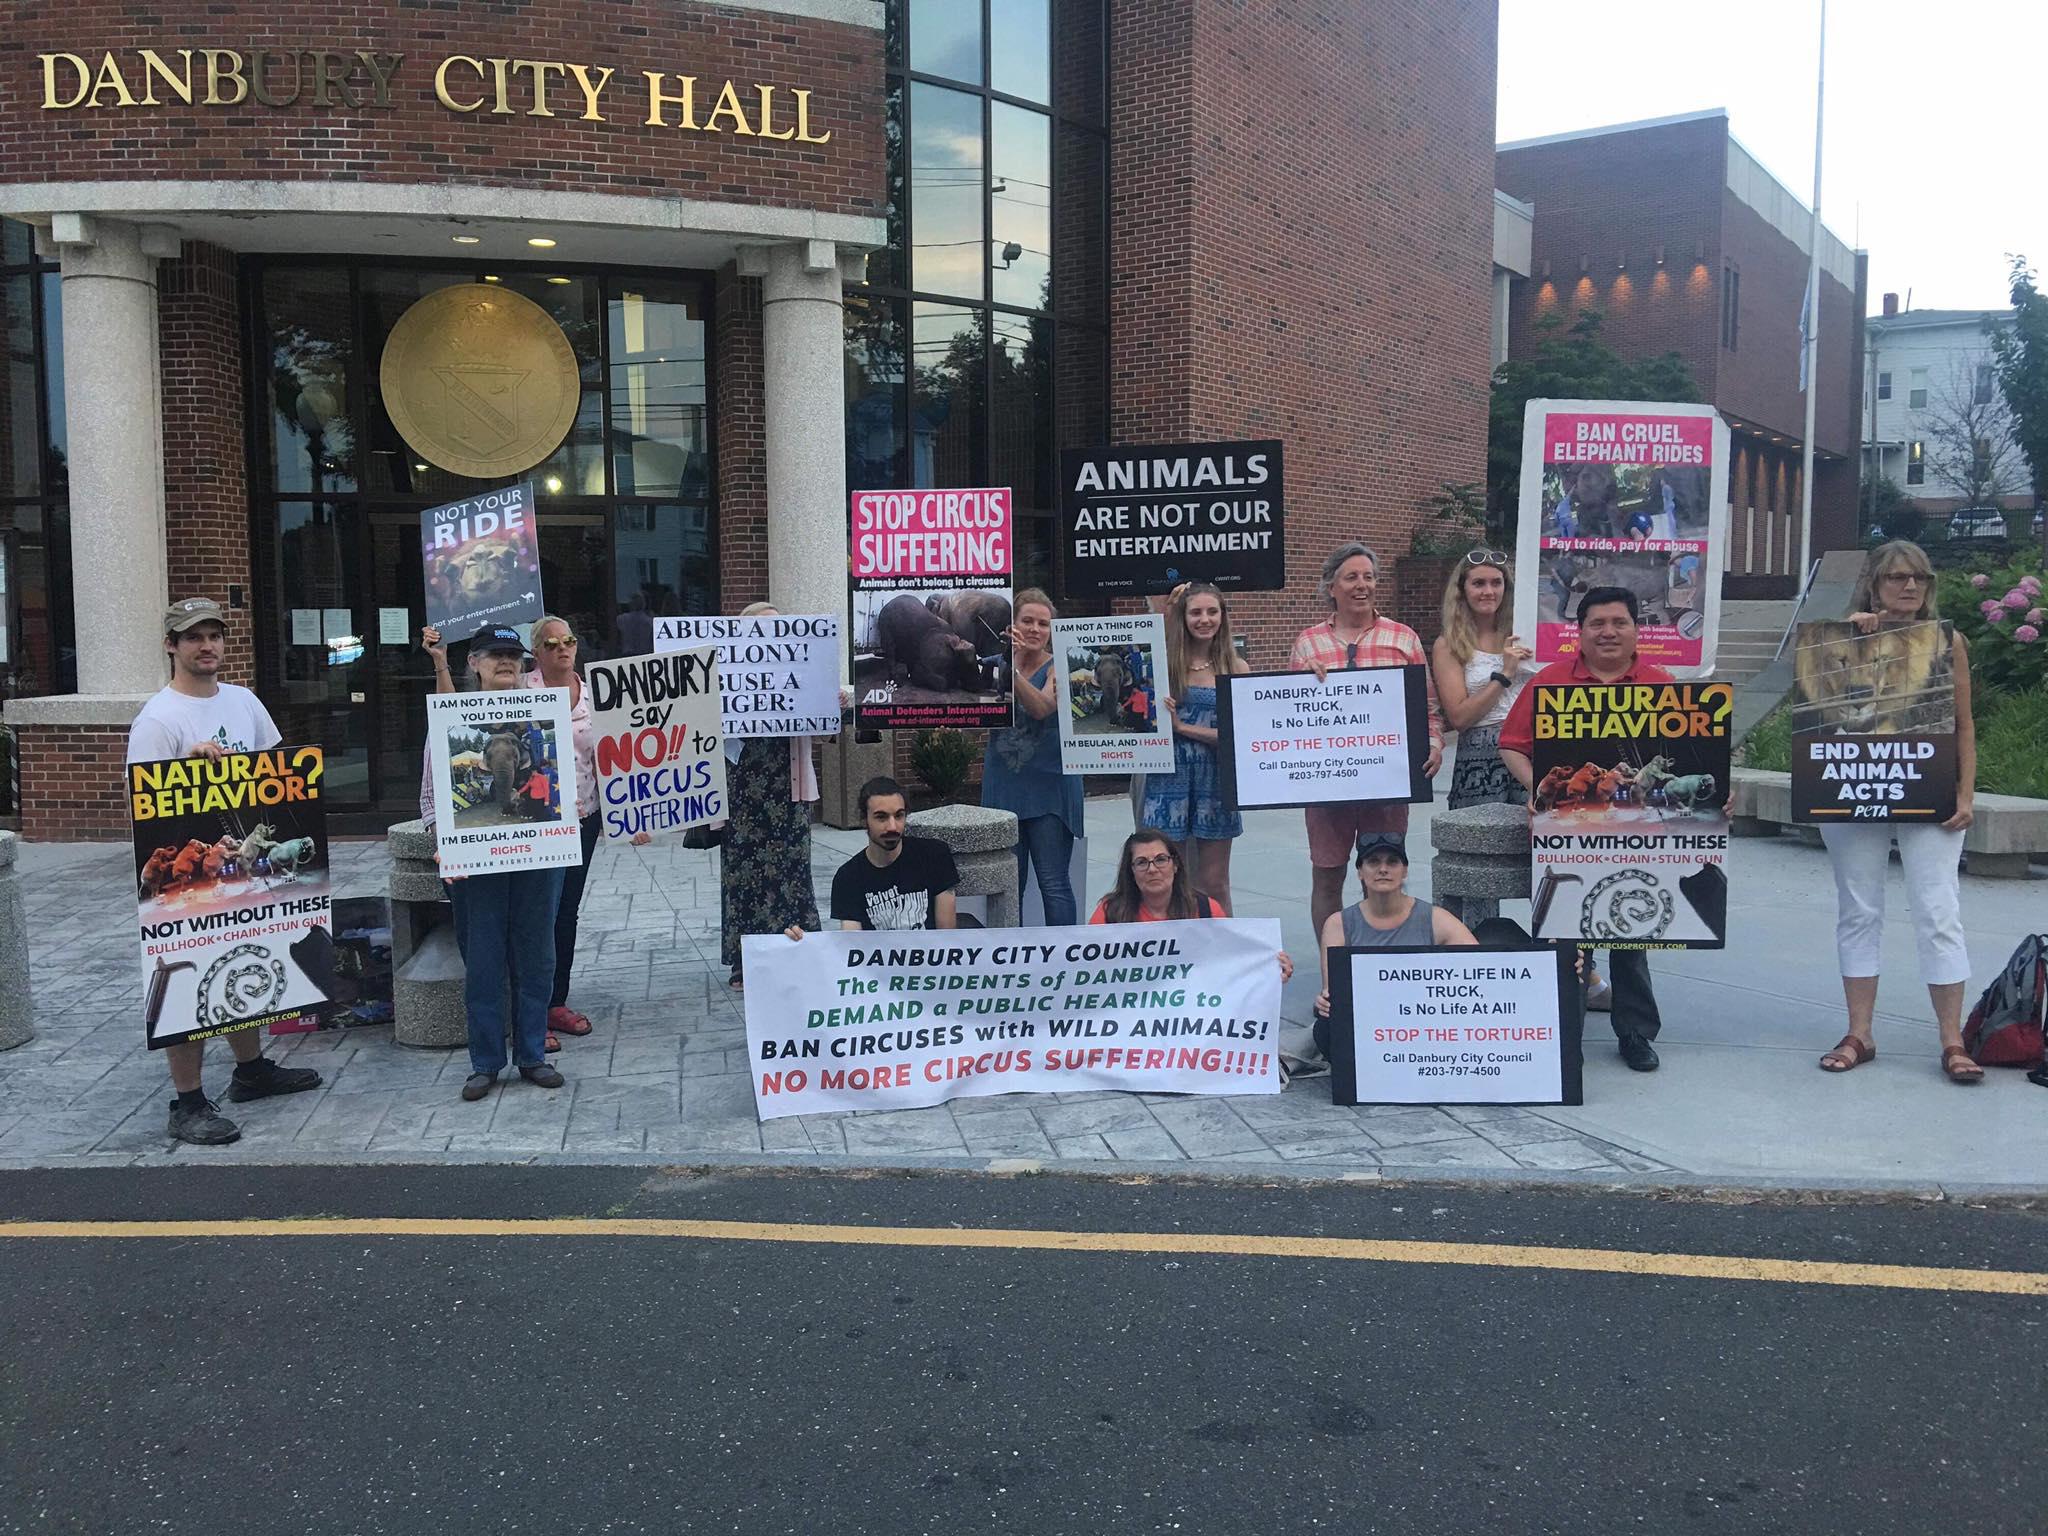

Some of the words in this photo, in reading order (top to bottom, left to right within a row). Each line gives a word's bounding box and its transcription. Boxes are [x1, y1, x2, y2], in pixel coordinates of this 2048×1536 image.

[37, 48, 405, 110] DANBURY
[433, 54, 614, 122] CITY
[642, 70, 832, 145] HALL
[1576, 422, 1616, 443] BAN
[1621, 423, 1683, 443] CRUEL
[1554, 442, 1648, 463] ELEPHANT
[1652, 444, 1703, 464] RIDES
[1075, 455, 1269, 491] ANIMALS
[434, 503, 469, 524] NOT
[473, 489, 522, 512] YOUR
[858, 495, 916, 531] STOP
[921, 492, 1004, 529] CIRCUS
[1074, 506, 1129, 531] ARE
[1141, 503, 1200, 528] NOT
[1209, 500, 1271, 525] OUR
[434, 503, 524, 549] RIDE
[859, 531, 1005, 574] SUFFERING
[1075, 531, 1272, 558] ENTERTAINMENT
[1549, 537, 1571, 551] Pay
[1574, 538, 1587, 550] to
[1589, 538, 1616, 553] ride,
[1619, 540, 1641, 553] pay
[1644, 540, 1662, 551] for
[1664, 541, 1699, 552] abuse
[859, 578, 896, 588] Animals
[898, 577, 921, 587] don't
[923, 577, 953, 588] belong
[956, 577, 964, 586] in
[966, 577, 1005, 586] circuses
[432, 620, 446, 629] not
[447, 616, 464, 625] your
[466, 600, 521, 619] entertainment
[656, 619, 742, 640] ABUSE
[749, 620, 766, 638] A
[774, 618, 837, 638] DOG:
[1060, 624, 1075, 632] AM
[1076, 623, 1094, 632] NOT
[1105, 622, 1133, 630] THING
[1135, 620, 1153, 629] FOR
[1077, 636, 1098, 644] YOU
[1098, 635, 1110, 643] TO
[1112, 634, 1133, 643] RIDE
[717, 643, 809, 664] ELONY!
[590, 649, 716, 712] DANBURY
[783, 671, 801, 690] A
[439, 699, 458, 709] AM
[460, 698, 484, 707] NOT
[486, 698, 496, 706] A
[497, 696, 532, 705] THING
[534, 694, 557, 703] FOR
[1254, 687, 1322, 701] DANBURY-
[1325, 685, 1353, 697] LIFE
[1357, 684, 1370, 695] IN
[1373, 683, 1383, 694] A
[722, 693, 794, 714] IGER:
[862, 707, 893, 716] Animal
[897, 706, 943, 716] Defenders
[947, 705, 1007, 715] International
[1294, 701, 1343, 713] TRUCK,
[461, 713, 486, 722] YOU
[488, 712, 504, 721] TO
[506, 710, 532, 719] RIDE
[630, 704, 673, 730] say
[1272, 719, 1282, 729] Is
[1286, 717, 1303, 728] No
[1307, 715, 1330, 727] Life
[1333, 715, 1346, 726] At
[1350, 714, 1370, 725] All!
[597, 724, 687, 777] NO!!
[692, 730, 717, 755] to
[1079, 739, 1116, 749] BEULAH,
[1118, 739, 1138, 747] AND
[1145, 738, 1169, 746] HAVE
[1251, 740, 1290, 753] STOP
[1294, 738, 1322, 750] THE
[1326, 734, 1401, 748] TORTURE!
[1810, 743, 1860, 760] END
[1867, 742, 1935, 759] WILD
[1101, 751, 1134, 759] RIGHTS
[1259, 761, 1278, 771] Call
[1281, 759, 1321, 771] Danbury
[1324, 758, 1344, 769] City
[1346, 755, 1384, 766] Council
[1289, 769, 1358, 781] #203-797-4500
[1822, 763, 1922, 780] ANIMAL
[605, 760, 711, 805] CIRCUS
[1837, 783, 1905, 800] ACTS
[606, 790, 721, 838] SUFFERING
[442, 836, 458, 846] I'M
[461, 832, 510, 844] BEULAH,
[511, 829, 537, 840] AND
[545, 826, 577, 836] HAVE
[1533, 836, 1574, 849] NOT
[1578, 835, 1667, 849] WITHOUT
[1672, 835, 1726, 849] THESE
[490, 845, 532, 856] RIGHTS
[500, 856, 533, 866] RIGHTS
[539, 853, 578, 863] PROJECT
[1659, 855, 1691, 864] STUN
[1695, 855, 1722, 864] GUN
[140, 921, 184, 941] NOT
[188, 904, 283, 931] WITHOUT
[281, 895, 330, 917] THESE
[269, 919, 299, 934] STUN
[302, 915, 328, 928] GUN
[847, 947, 983, 968] DANBURY
[992, 944, 1056, 964] CITY
[1065, 938, 1182, 961] COUNCIL
[837, 977, 879, 997] The
[888, 973, 1032, 992] RESIDENTS
[1040, 970, 1066, 992] of
[1074, 962, 1194, 986] DANBURY
[1379, 969, 1459, 982] DANBURY-
[1464, 968, 1496, 980] LIFE
[1501, 968, 1517, 979] IN
[1520, 967, 1532, 979] A
[1426, 986, 1484, 999] TRUCK,
[807, 1002, 924, 1029] DEMAND
[932, 1001, 948, 1017] a
[957, 994, 1053, 1015] PUBLIC
[1063, 990, 1185, 1011] HEARING
[1196, 992, 1222, 1009] to
[1399, 1004, 1411, 1016] Is
[1416, 1003, 1436, 1016] No
[1442, 1002, 1468, 1015] Life
[1471, 1003, 1488, 1014] At
[1492, 1002, 1516, 1014] All!
[188, 1011, 301, 1042] WWW.CIRCUSPROTEST.COM
[1374, 1028, 1420, 1042] STOP
[1424, 1028, 1458, 1041] THE
[1464, 1027, 1553, 1041] TORTURE!
[761, 1039, 820, 1060] BAN
[830, 1025, 964, 1059] CIRCUSES
[975, 1020, 1035, 1042] with
[1048, 1019, 1119, 1039] WILD
[1129, 1017, 1268, 1040] ANIMALS!
[1383, 1053, 1405, 1064] Call
[1408, 1053, 1457, 1065] Danbury
[1461, 1053, 1484, 1065] City
[1487, 1052, 1532, 1063] Council
[762, 1071, 808, 1096] NO
[820, 1061, 911, 1090] MORE
[924, 1049, 1031, 1081] CIRCUS
[1418, 1066, 1501, 1077] #203-797-4500
